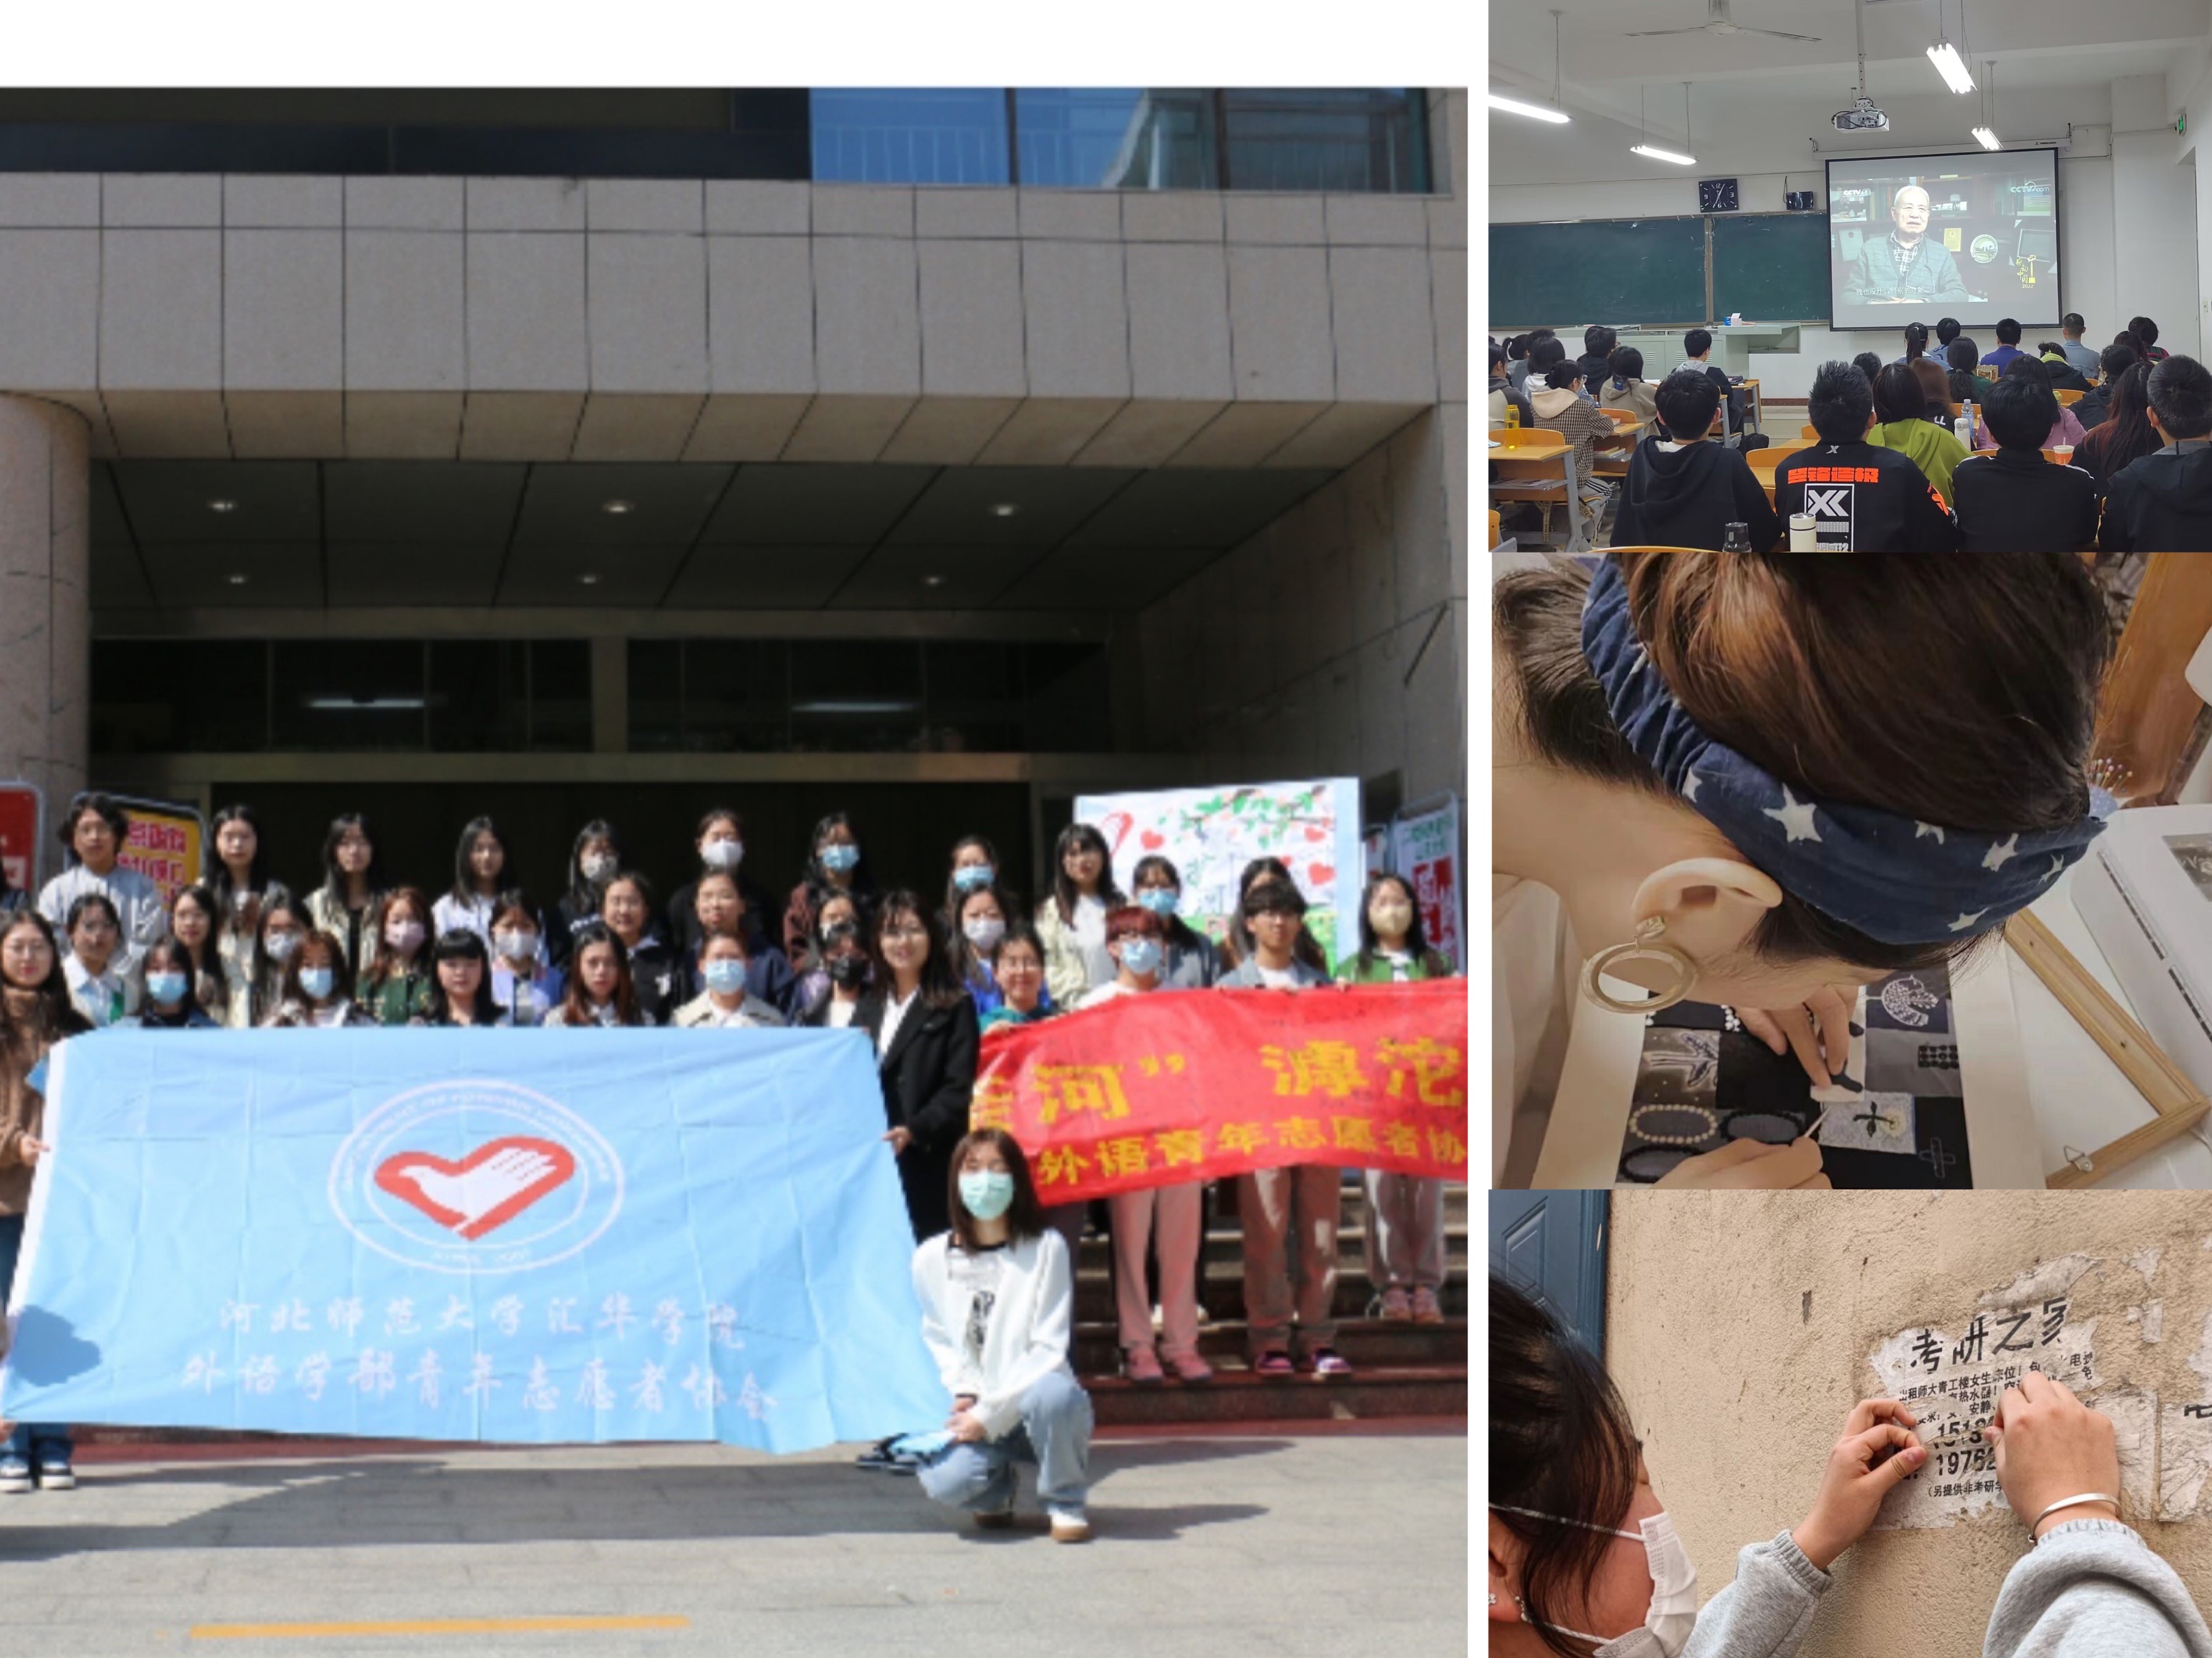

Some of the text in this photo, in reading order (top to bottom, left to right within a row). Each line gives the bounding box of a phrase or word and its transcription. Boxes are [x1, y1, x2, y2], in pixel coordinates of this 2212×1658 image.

[1856, 286, 1926, 296] 我也没什么特别的才能
[1037, 1115, 1467, 1186] 外语青年志愿者协
[220, 1292, 745, 1350] 河北师范大学汇华学院
[182, 1346, 778, 1421] 外语学部青年志愿者协会
